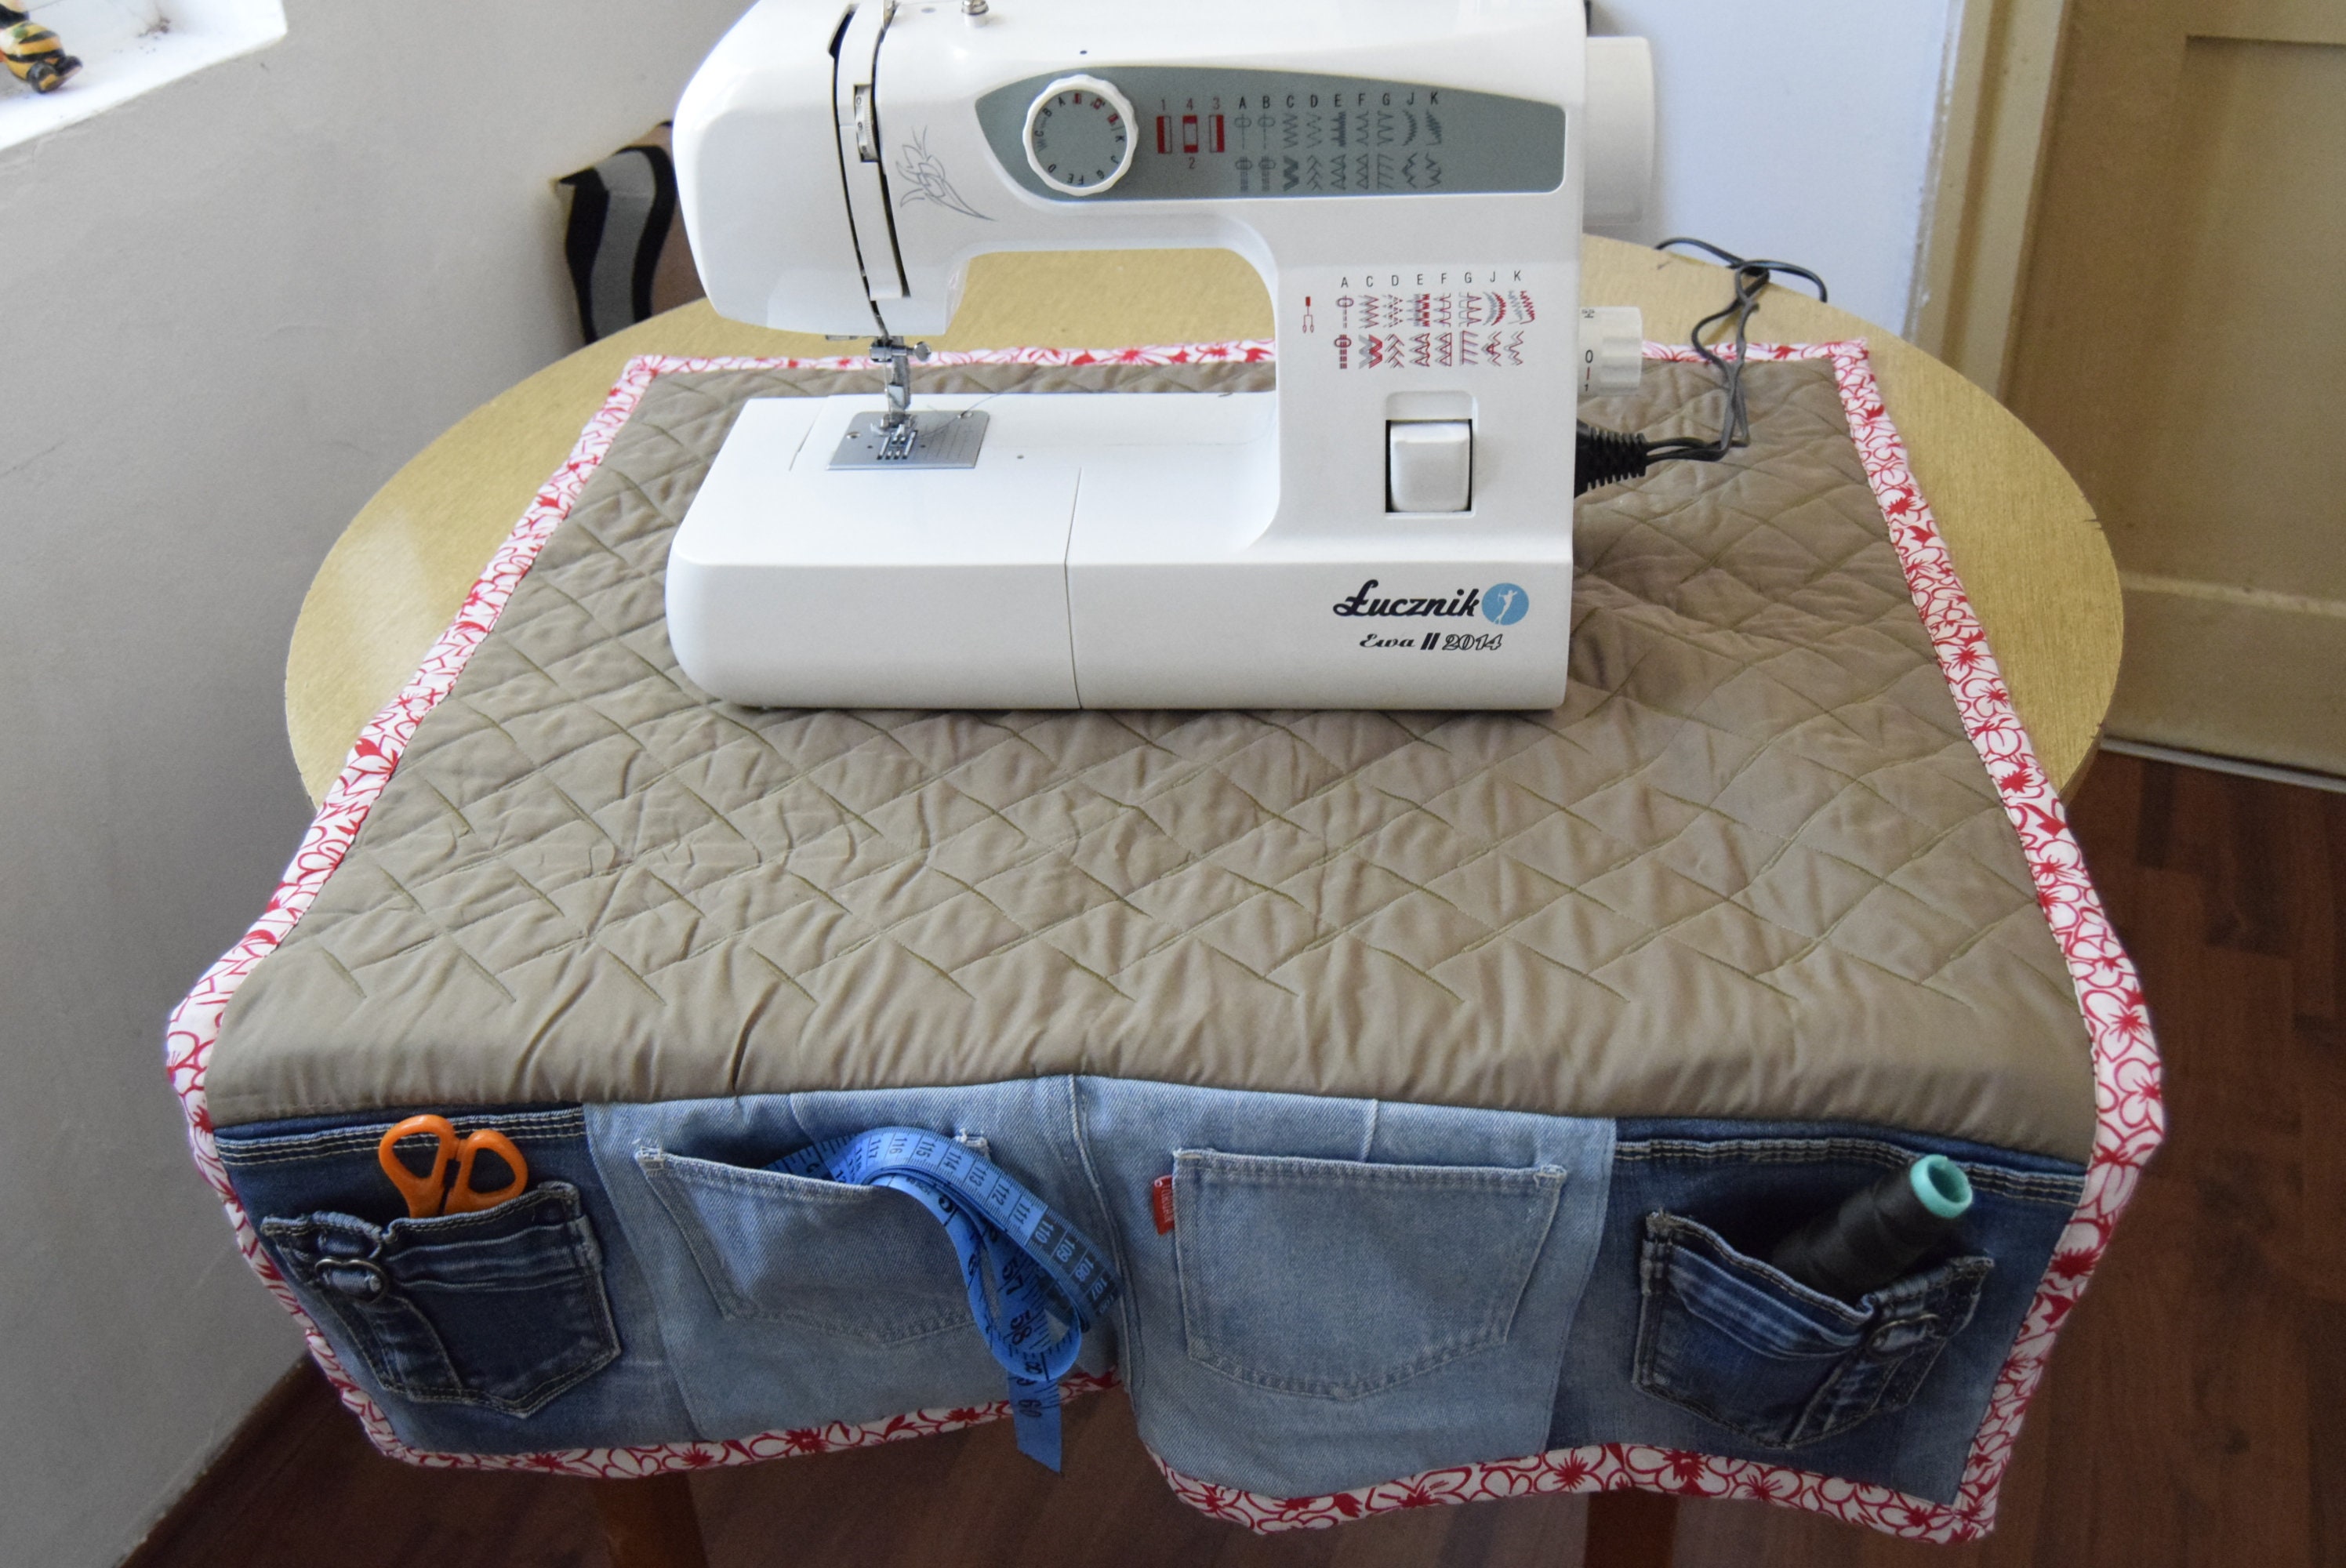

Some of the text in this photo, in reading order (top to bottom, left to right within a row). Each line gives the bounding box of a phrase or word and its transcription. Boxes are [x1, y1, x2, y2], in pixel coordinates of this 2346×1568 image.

[1161, 97, 1220, 111] 1 4 3
[1239, 93, 1439, 109] A B C D E F G J K
[1189, 158, 1195, 169] 2
[1341, 270, 1521, 288] A C D E F G J K
[1585, 350, 1593, 363] 0
[1333, 579, 1480, 616] Łucznik
[1360, 633, 1415, 648] Ewa
[1442, 633, 1503, 651] 2014
[869, 1139, 881, 1158] 117
[890, 1138, 907, 1154] 116
[917, 1140, 936, 1158] 115
[943, 1151, 962, 1171] 114
[969, 1166, 988, 1187] 113
[992, 1183, 1010, 1206] 112
[1012, 1203, 1030, 1225] 111
[1035, 1220, 1054, 1243] 110
[1056, 1239, 1076, 1263] 109
[1075, 1258, 1094, 1282] 108
[1091, 1277, 1108, 1301] 107
